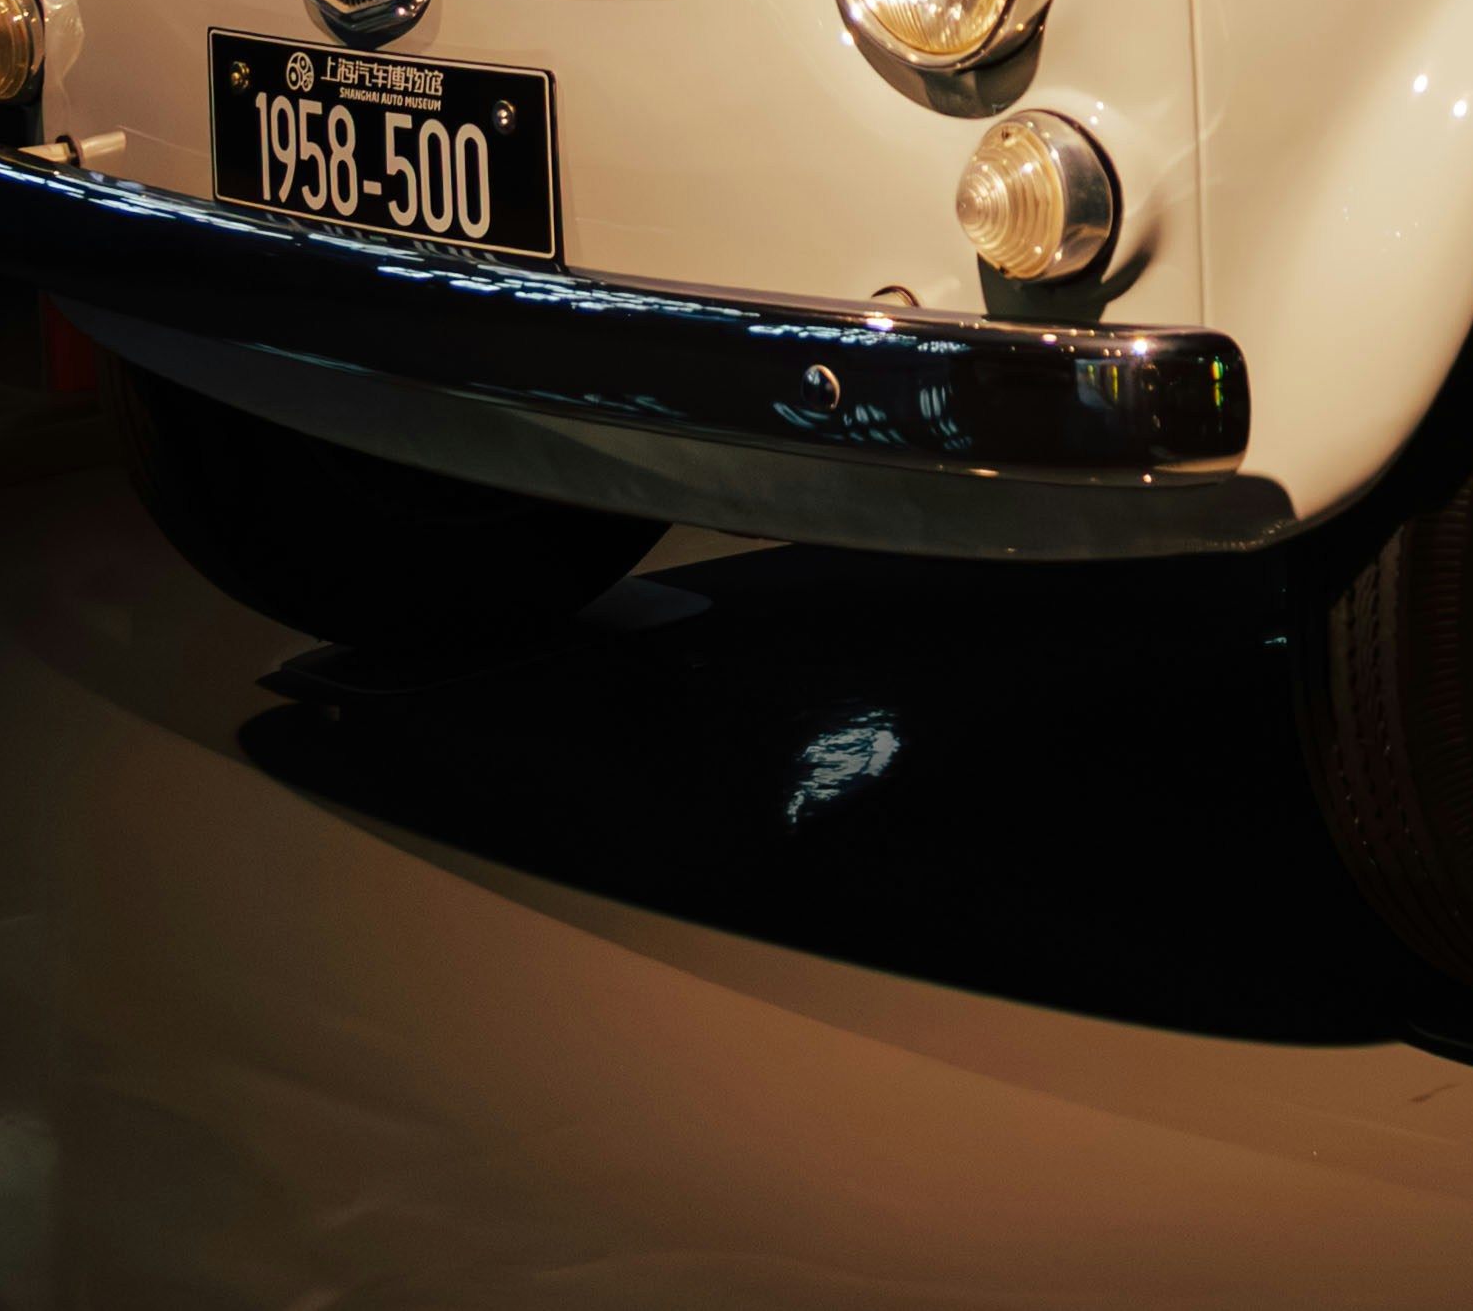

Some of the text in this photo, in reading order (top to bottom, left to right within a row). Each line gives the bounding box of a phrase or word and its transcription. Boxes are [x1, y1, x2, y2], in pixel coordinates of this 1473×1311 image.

[321, 56, 444, 96] 上海汽车博物馆
[339, 86, 442, 111] SHANGHAI AUTO MUSEUM
[255, 91, 492, 240] 1958-500
